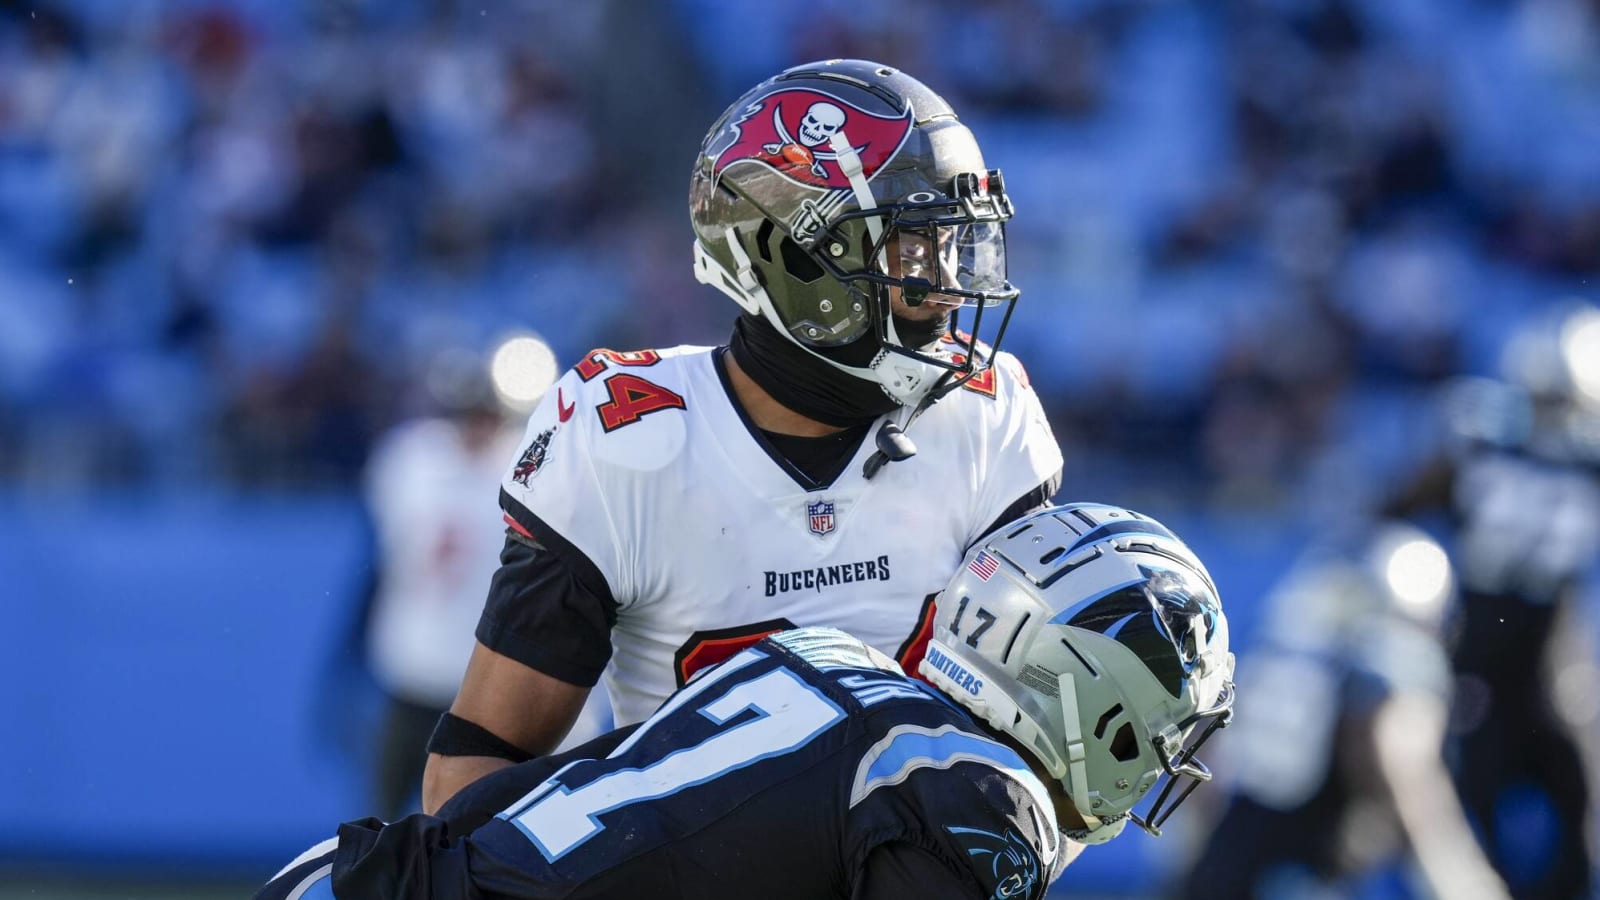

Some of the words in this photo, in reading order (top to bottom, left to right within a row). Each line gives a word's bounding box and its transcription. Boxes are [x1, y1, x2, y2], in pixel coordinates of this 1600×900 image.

[573, 348, 687, 433] 24
[811, 515, 833, 532] NFL
[763, 555, 890, 597] BUCCANEERS
[950, 596, 997, 649] 17
[926, 646, 983, 696] PANTHERS
